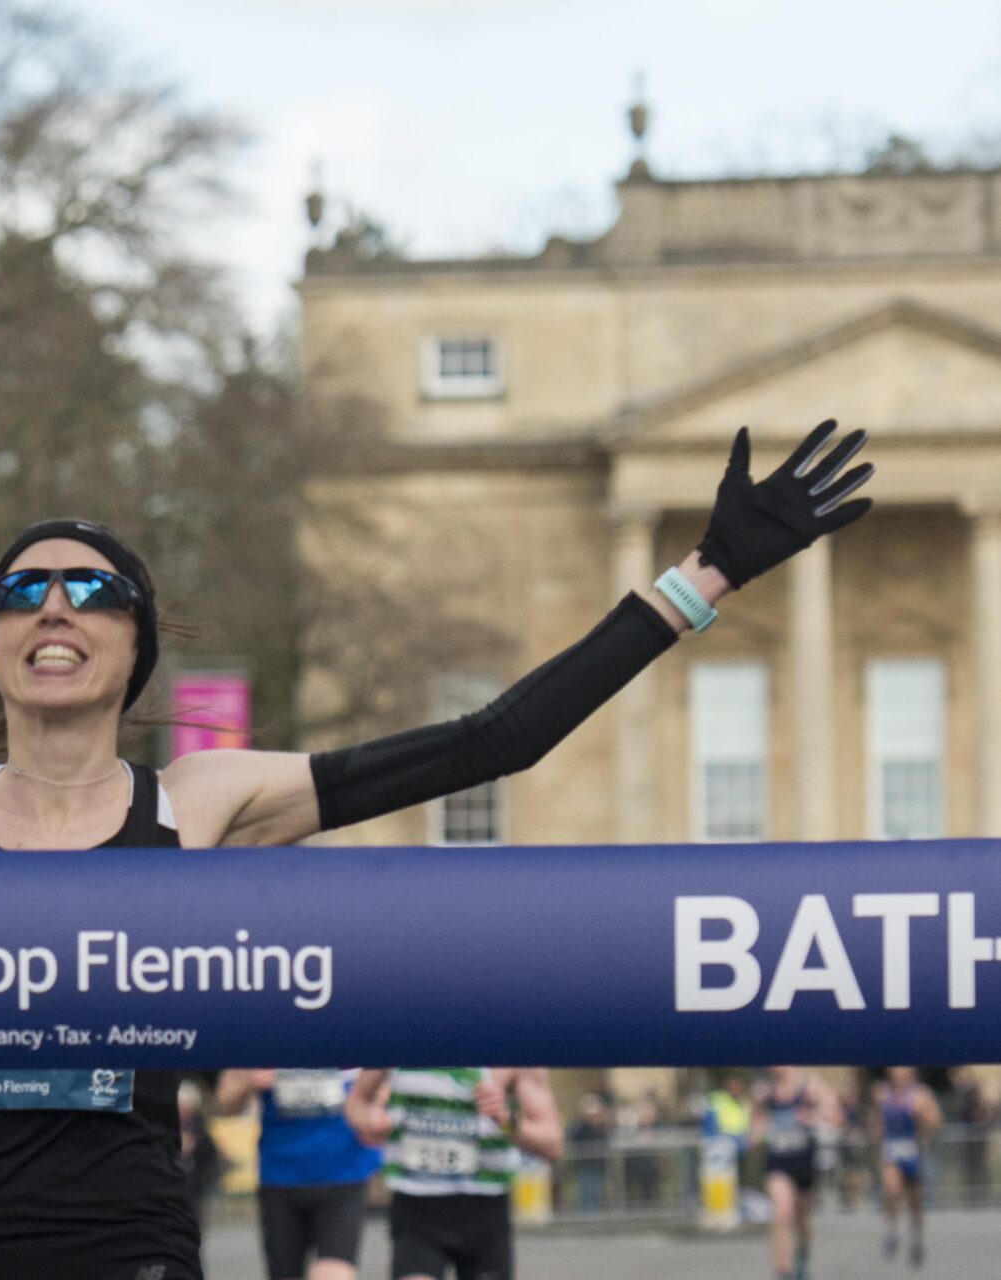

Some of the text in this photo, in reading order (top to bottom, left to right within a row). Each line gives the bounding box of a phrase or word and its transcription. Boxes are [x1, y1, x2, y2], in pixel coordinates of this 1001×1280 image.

[77, 929, 333, 1010] Fleming
[54, 1024, 92, 1045] Tax
[107, 1024, 197, 1050] Advisory
[3, 1080, 50, 1096] Fleming
